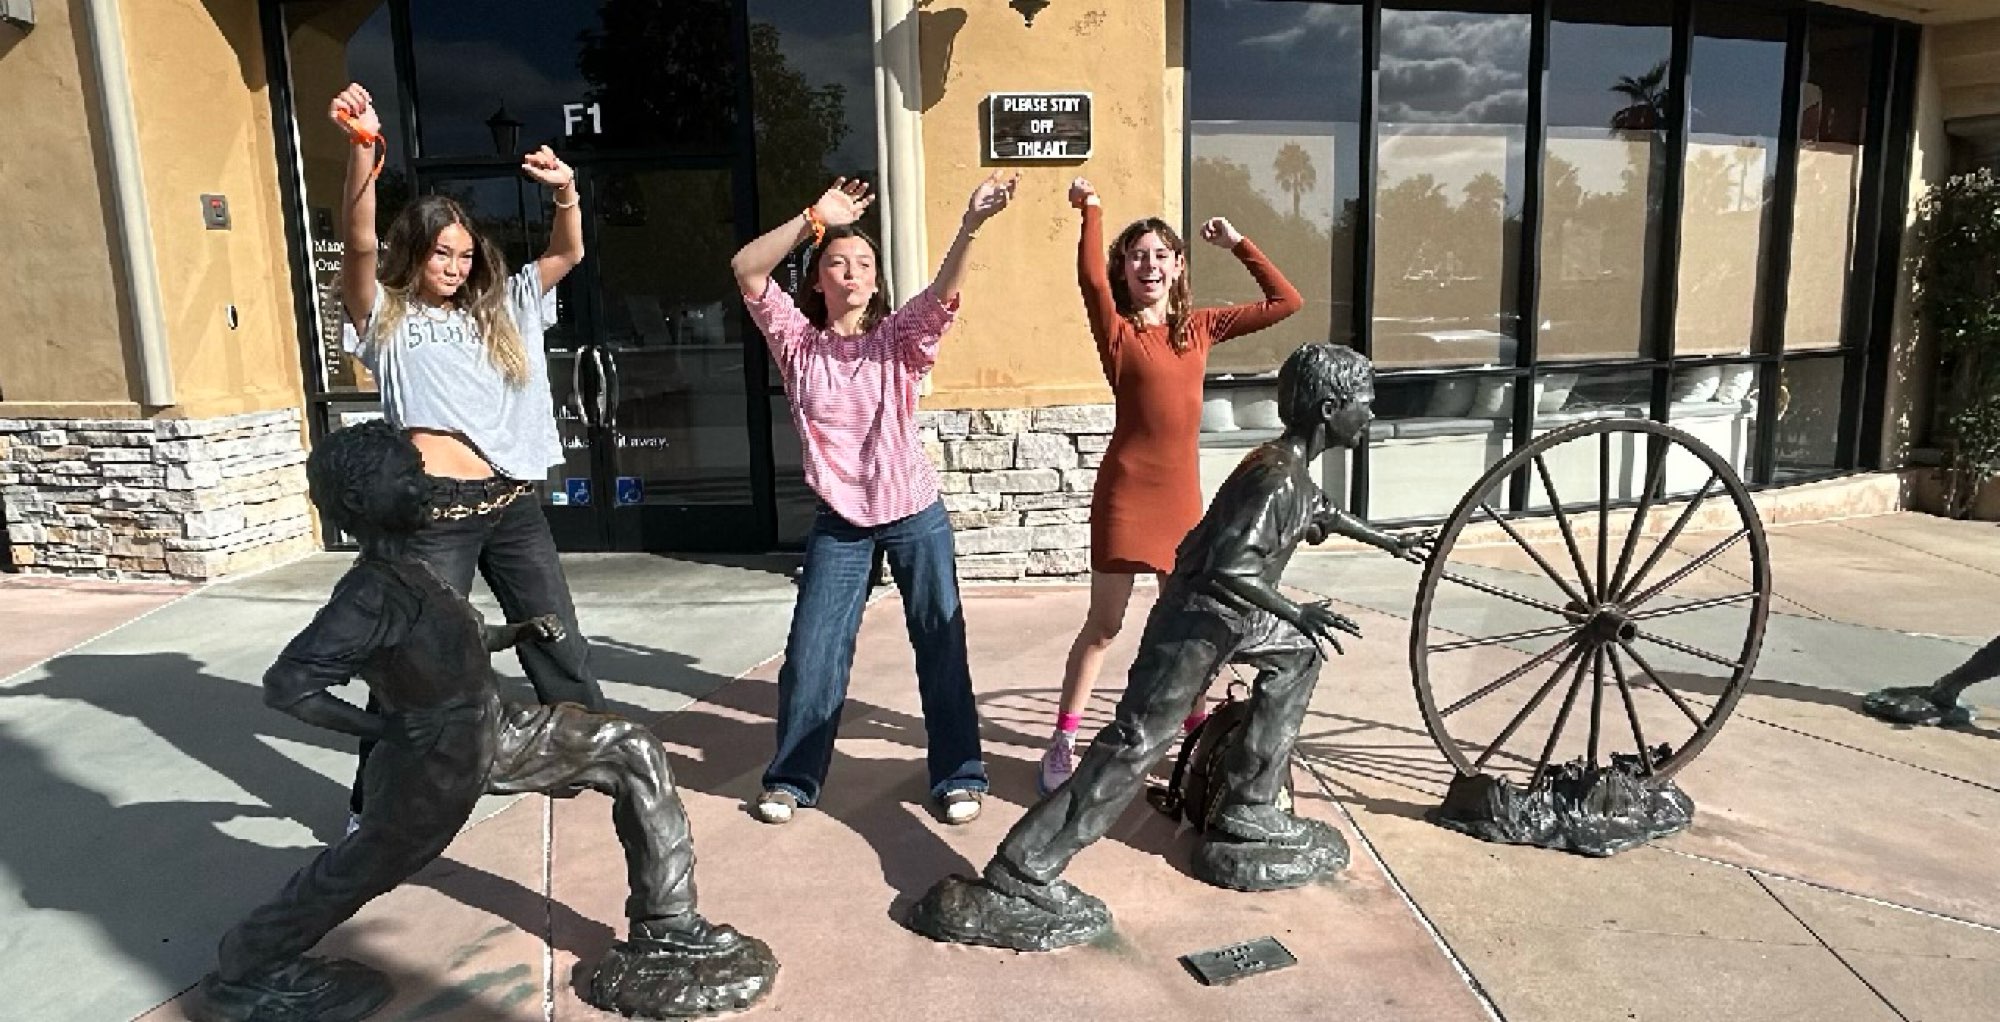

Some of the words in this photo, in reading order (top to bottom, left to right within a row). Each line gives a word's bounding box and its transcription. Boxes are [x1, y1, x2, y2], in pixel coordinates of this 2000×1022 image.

[1003, 98, 1047, 112] PLEASE
[1049, 98, 1080, 112] STAY
[563, 102, 602, 137] F1
[1030, 119, 1054, 133] OFF
[1016, 141, 1041, 156] THE
[1042, 141, 1067, 156] ART
